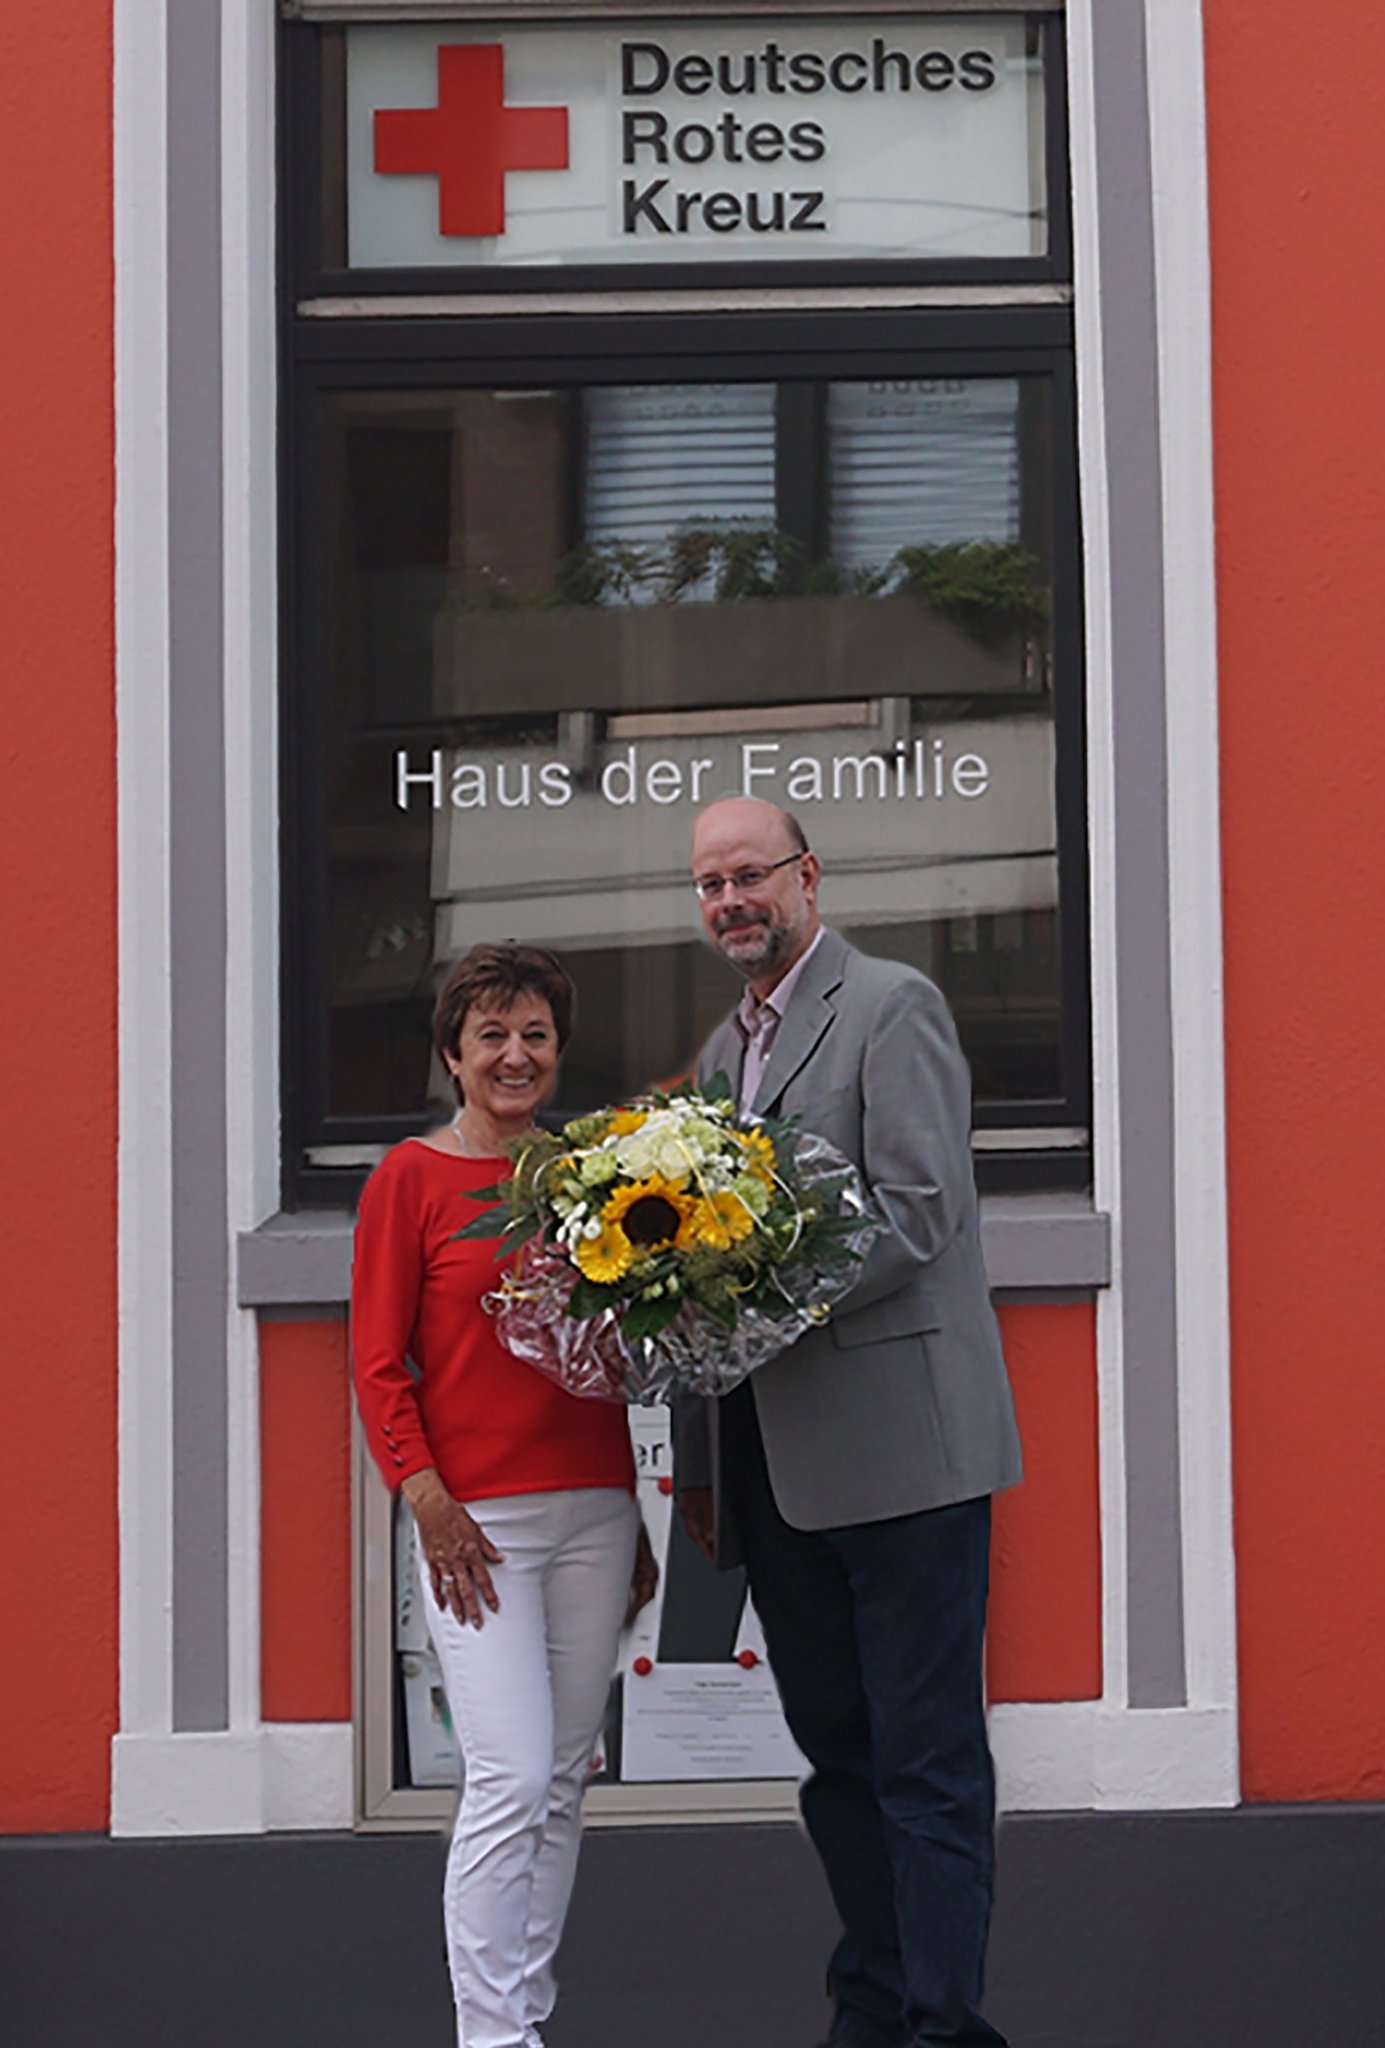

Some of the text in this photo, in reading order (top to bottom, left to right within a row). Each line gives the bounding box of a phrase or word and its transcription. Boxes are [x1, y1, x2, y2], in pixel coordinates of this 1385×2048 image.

[621, 39, 995, 96] Deutsches
[622, 110, 826, 166] Rotes
[622, 178, 827, 235] Kreuz
[396, 740, 989, 809] Haus der Familie
